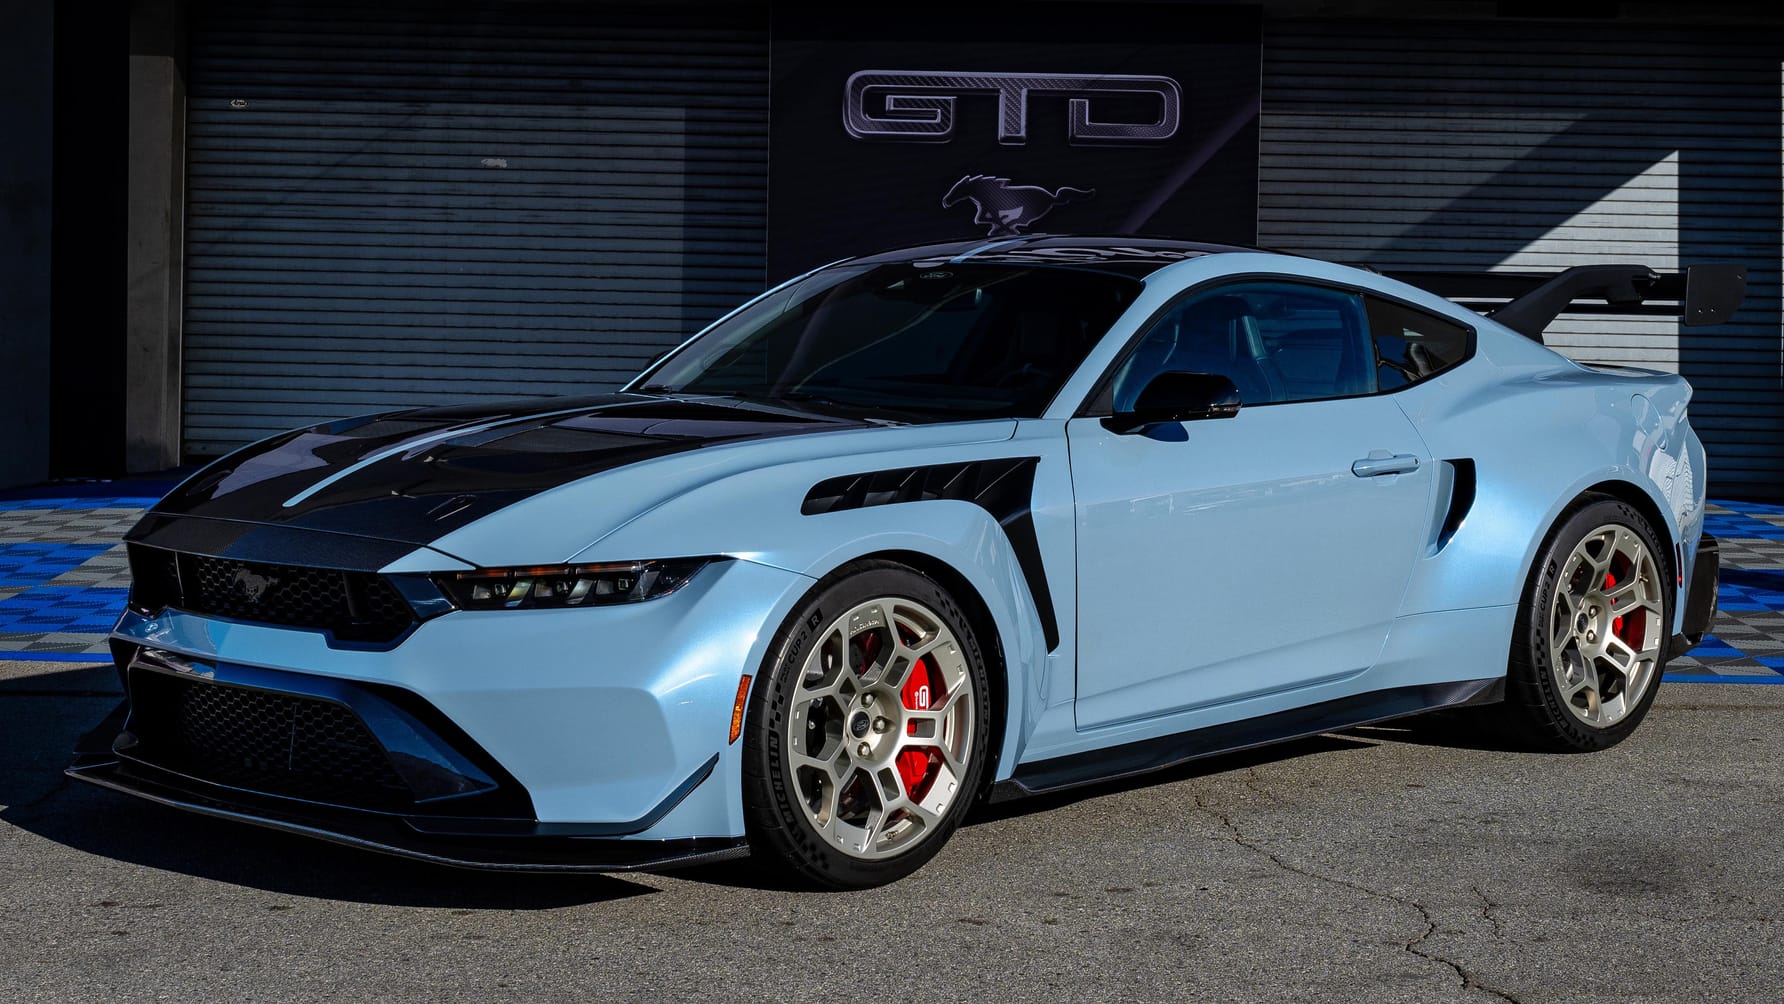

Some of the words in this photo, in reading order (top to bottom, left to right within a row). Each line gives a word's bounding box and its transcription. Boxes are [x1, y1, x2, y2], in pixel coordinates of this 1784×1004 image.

[843, 70, 1182, 146] GTD
[1540, 588, 1548, 611] CUP
[787, 641, 802, 665] CUP
[800, 630, 808, 641] 2
[768, 730, 800, 827] MICHELIN
